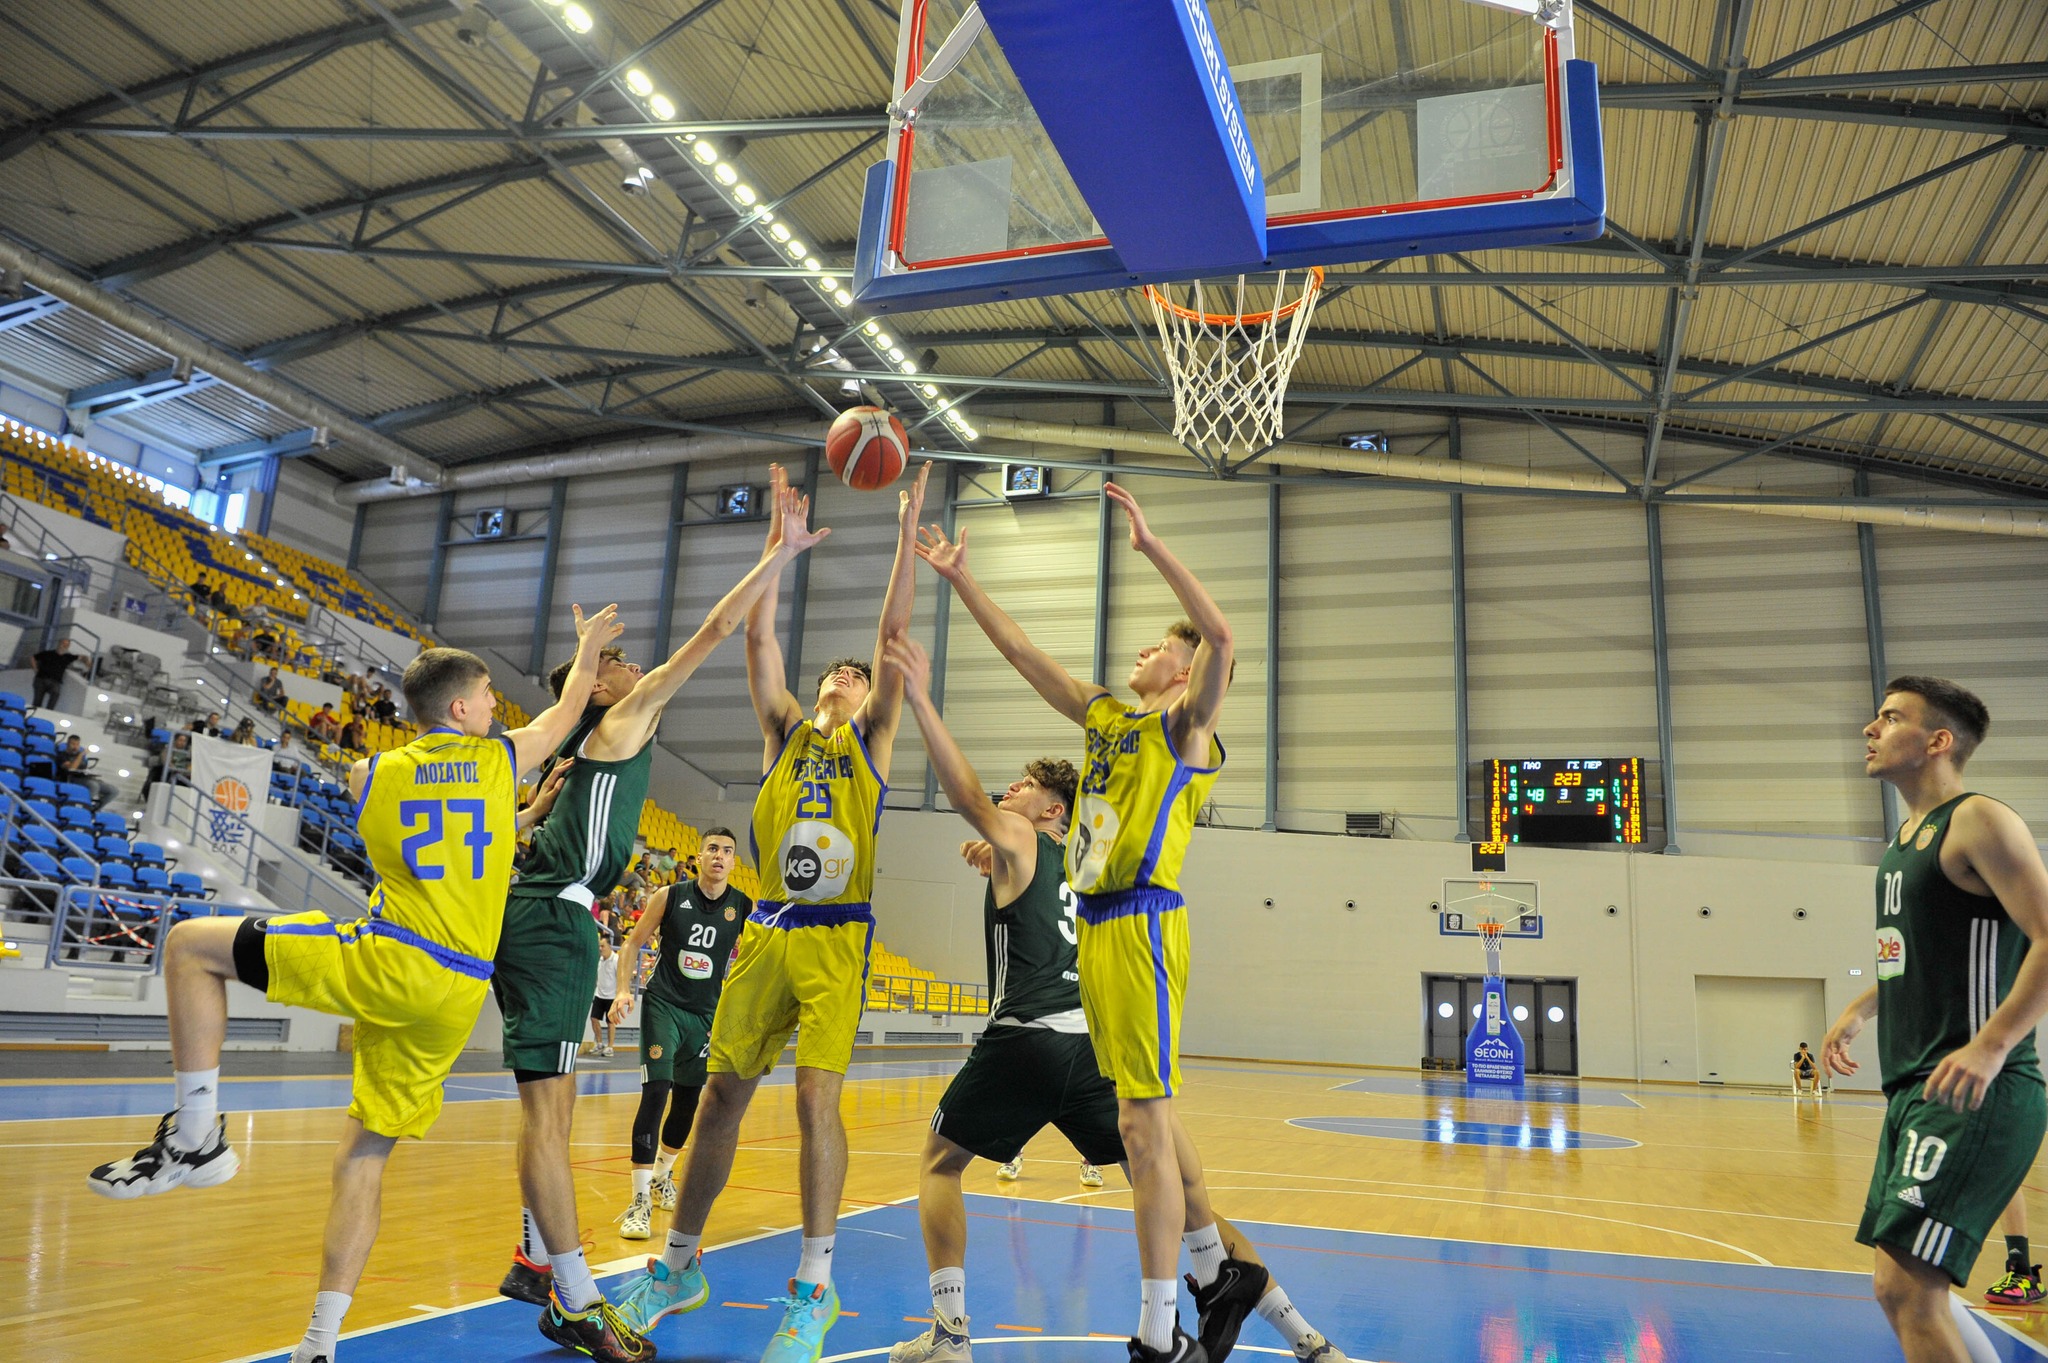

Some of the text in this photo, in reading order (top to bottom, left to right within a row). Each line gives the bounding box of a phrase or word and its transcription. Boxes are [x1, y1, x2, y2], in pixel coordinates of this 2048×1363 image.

[1187, 0, 1255, 188] PORT SYSTEM
[1523, 761, 1541, 770] ΠΑΟ
[1567, 760, 1602, 770] ΓΣ ΠΕΡ
[1553, 773, 1582, 786] 2:23
[1527, 788, 1545, 802] 48
[1560, 788, 1568, 800] 3
[1586, 788, 1604, 802] 39
[1525, 804, 1533, 815] 4
[1597, 804, 1605, 815] 3
[400, 799, 492, 880] 27
[1480, 843, 1505, 854] 2:23
[1884, 870, 1903, 916] 10
[688, 923, 717, 949] 20
[684, 956, 709, 969] Dole
[1474, 1047, 1514, 1059] ΘΕΟΝΗ
[1902, 1128, 1948, 1181] 10
